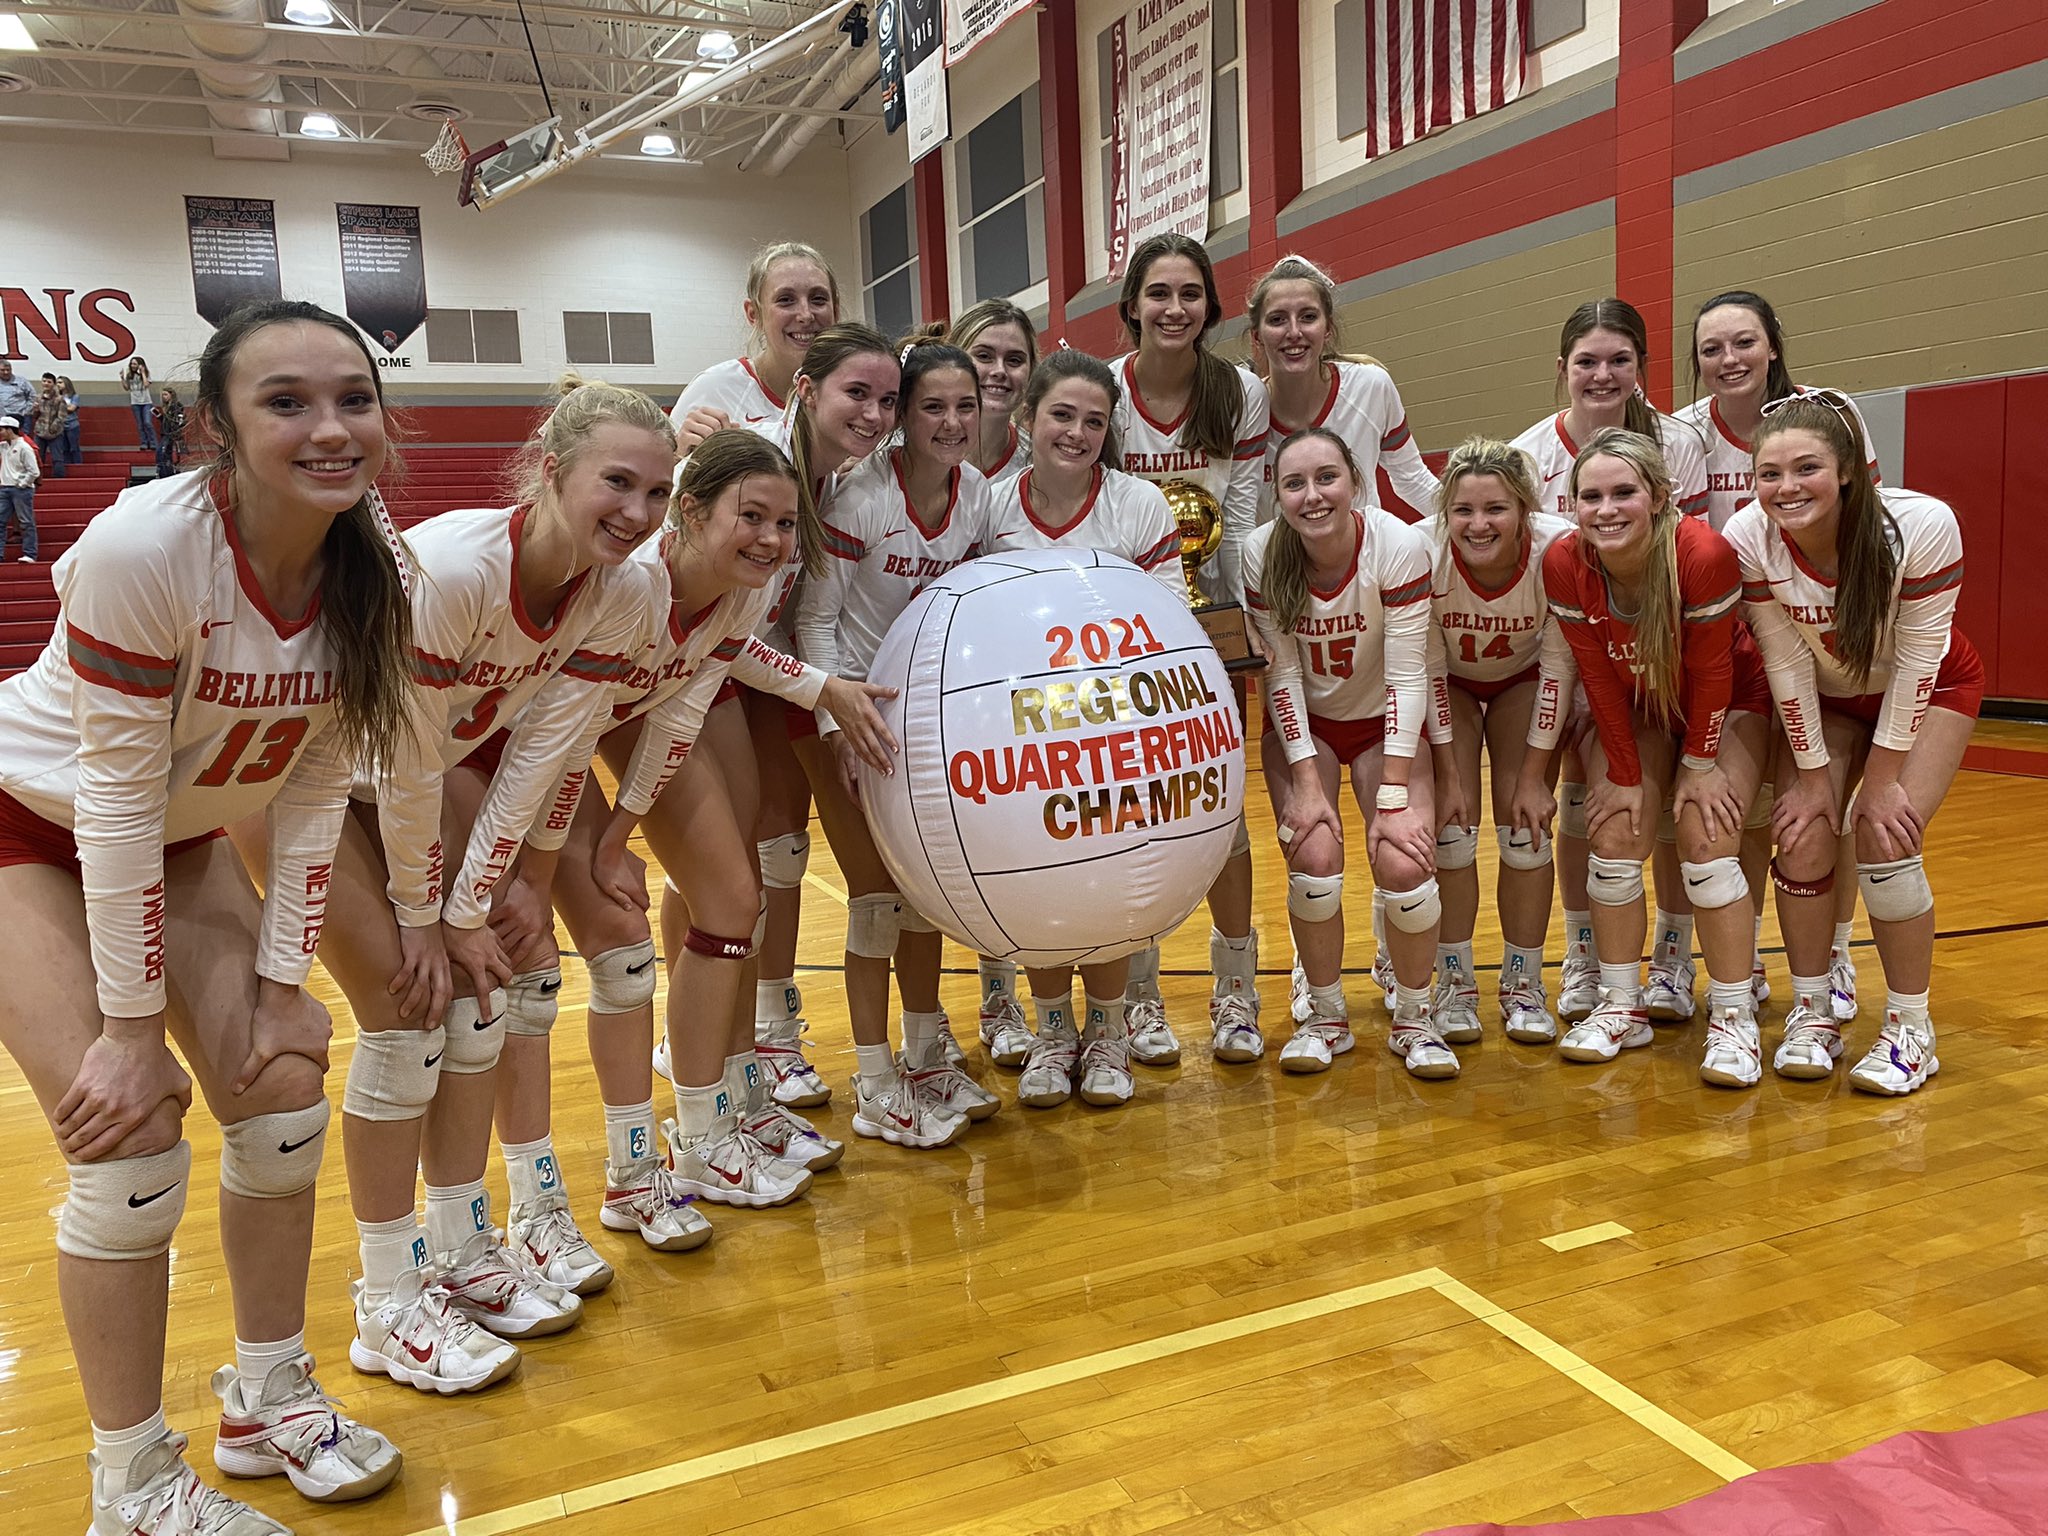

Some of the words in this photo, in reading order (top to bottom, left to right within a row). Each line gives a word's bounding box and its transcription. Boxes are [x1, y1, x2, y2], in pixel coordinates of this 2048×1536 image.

[911, 18, 933, 52] 2016
[1137, 0, 1163, 35] ALMA
[1169, 19, 1187, 43] High
[949, 37, 966, 55] TEXAS
[187, 207, 273, 221] SPARTANS
[338, 213, 419, 228] SPARTANS
[375, 357, 411, 368] OME
[1045, 613, 1166, 669] 2021
[1442, 612, 1535, 633] BELLVILLE
[746, 638, 805, 678] BRAHMA
[1308, 636, 1357, 680] 15
[1459, 633, 1515, 663] 14
[194, 666, 339, 709] BELLVILL
[1010, 661, 1218, 737] REGIONAL
[1432, 677, 1451, 727] BRAHMA
[1538, 678, 1559, 731] NETTES
[1272, 687, 1301, 742] BRAHMA
[1780, 697, 1810, 752] BRAHMA
[192, 716, 310, 787] 13
[950, 706, 1241, 805] QUARTERFINAL
[546, 769, 587, 831] BRAHMA
[1043, 763, 1229, 841] CHAMPS!
